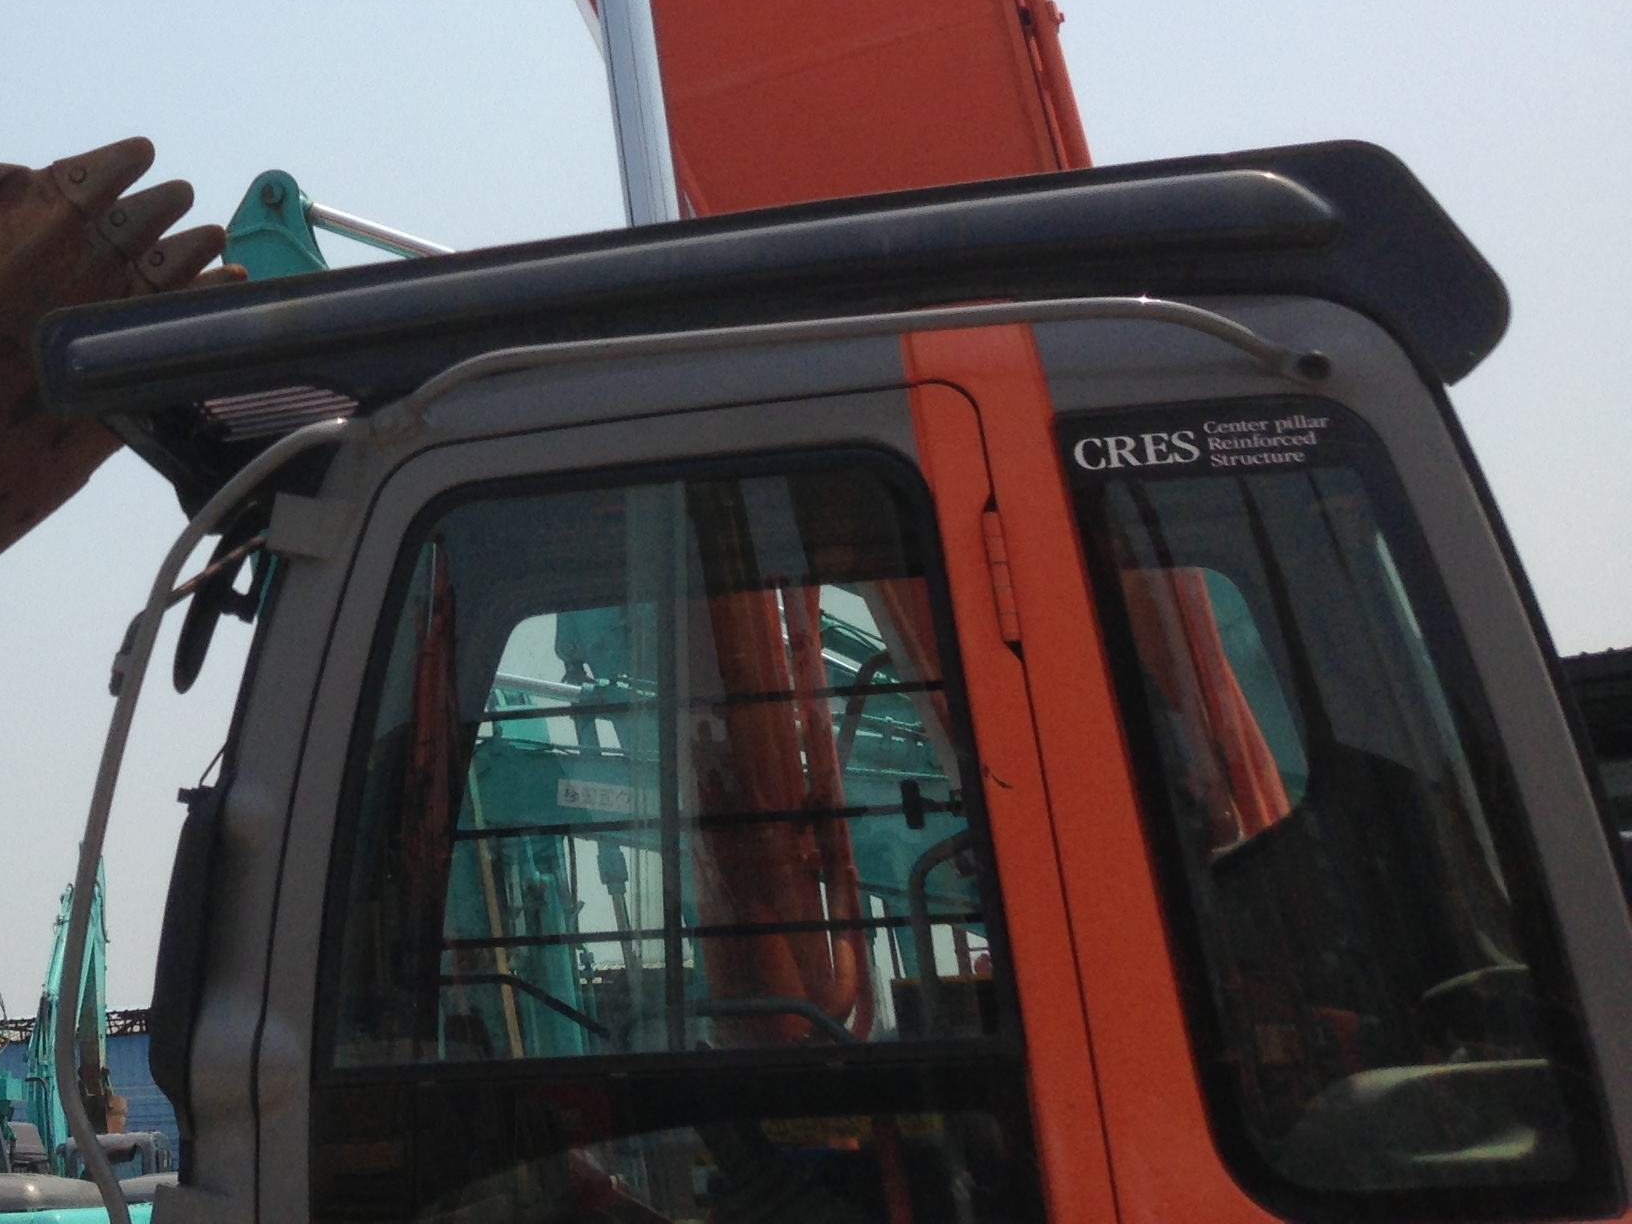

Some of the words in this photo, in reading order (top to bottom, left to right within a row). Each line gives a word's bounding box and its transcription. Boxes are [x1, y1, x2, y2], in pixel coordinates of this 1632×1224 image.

[1203, 421, 1268, 434] Center
[1274, 415, 1329, 434] pillar
[1073, 430, 1200, 470] CRES
[1208, 431, 1317, 450] Reinforced
[1210, 452, 1305, 467] Structure
